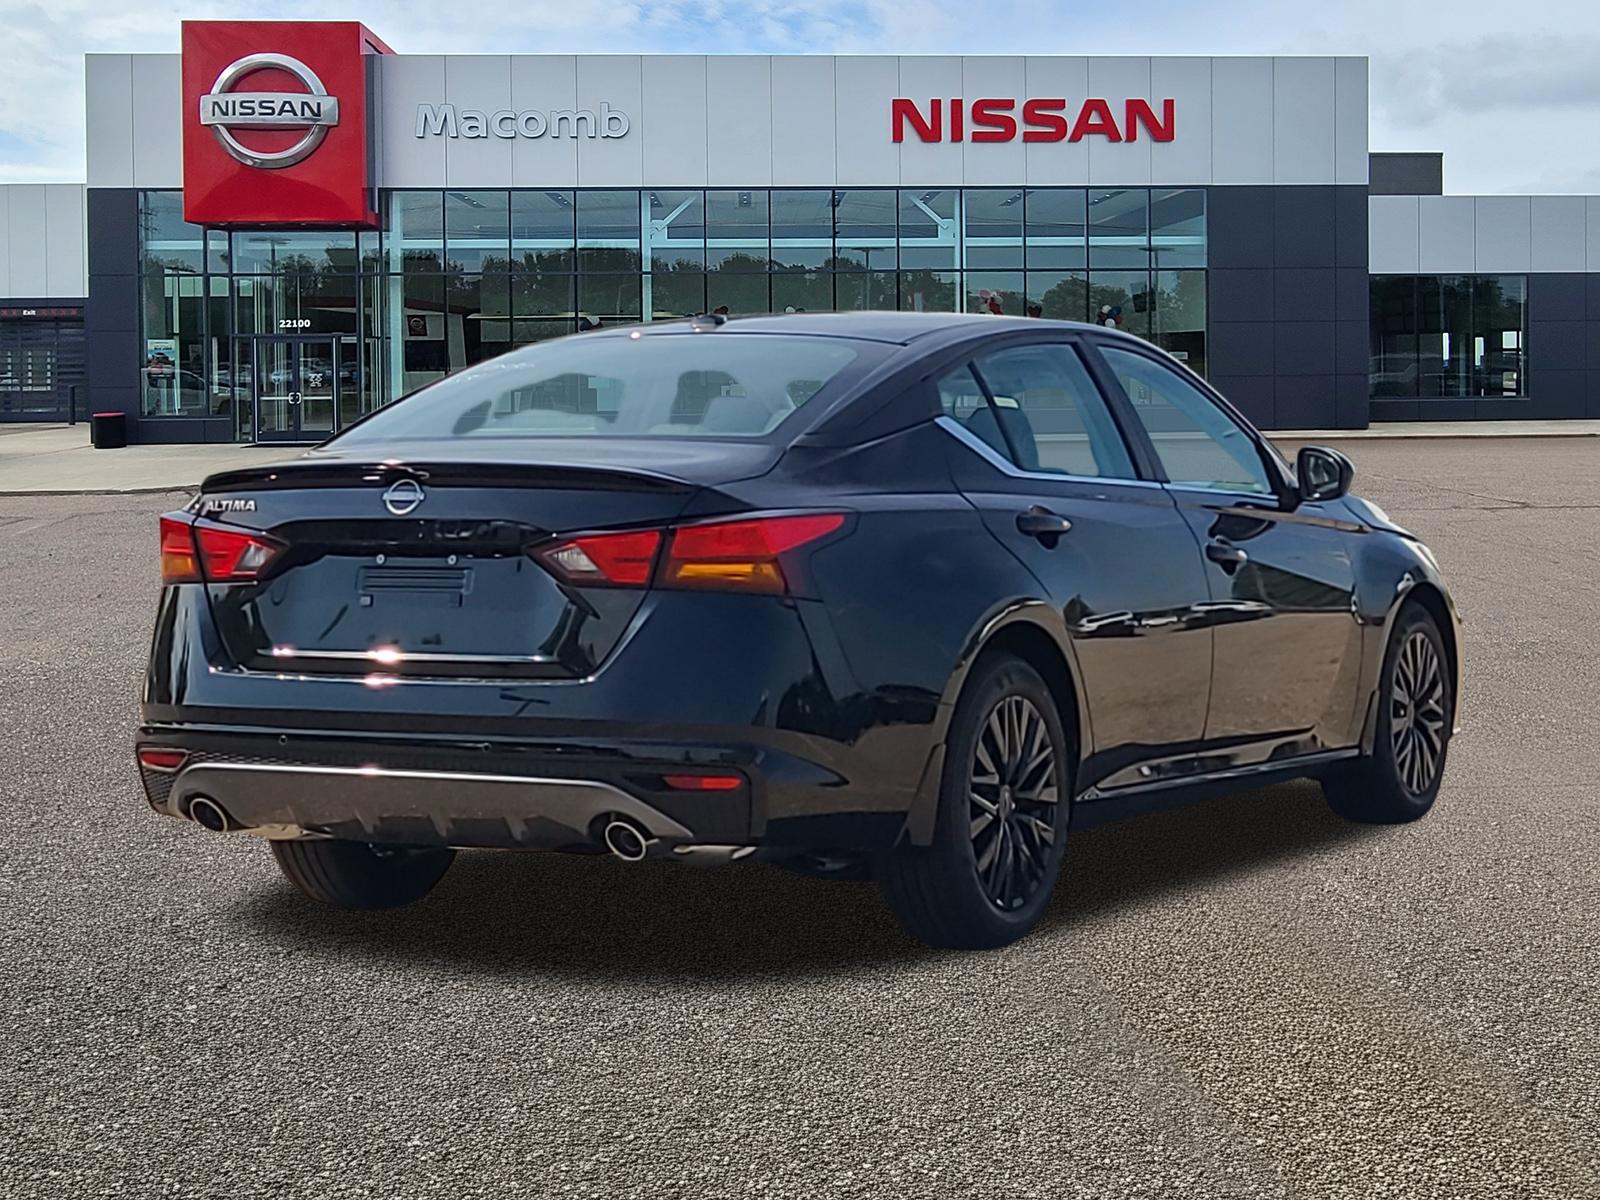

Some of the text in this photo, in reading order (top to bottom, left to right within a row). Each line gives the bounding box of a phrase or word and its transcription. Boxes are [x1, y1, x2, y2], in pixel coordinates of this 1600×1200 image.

[212, 100, 322, 117] NISSAN
[415, 102, 630, 138] Macomb
[892, 98, 1175, 142] NISSAN
[279, 319, 311, 328] 22100
[205, 499, 256, 512] ALTIMA
